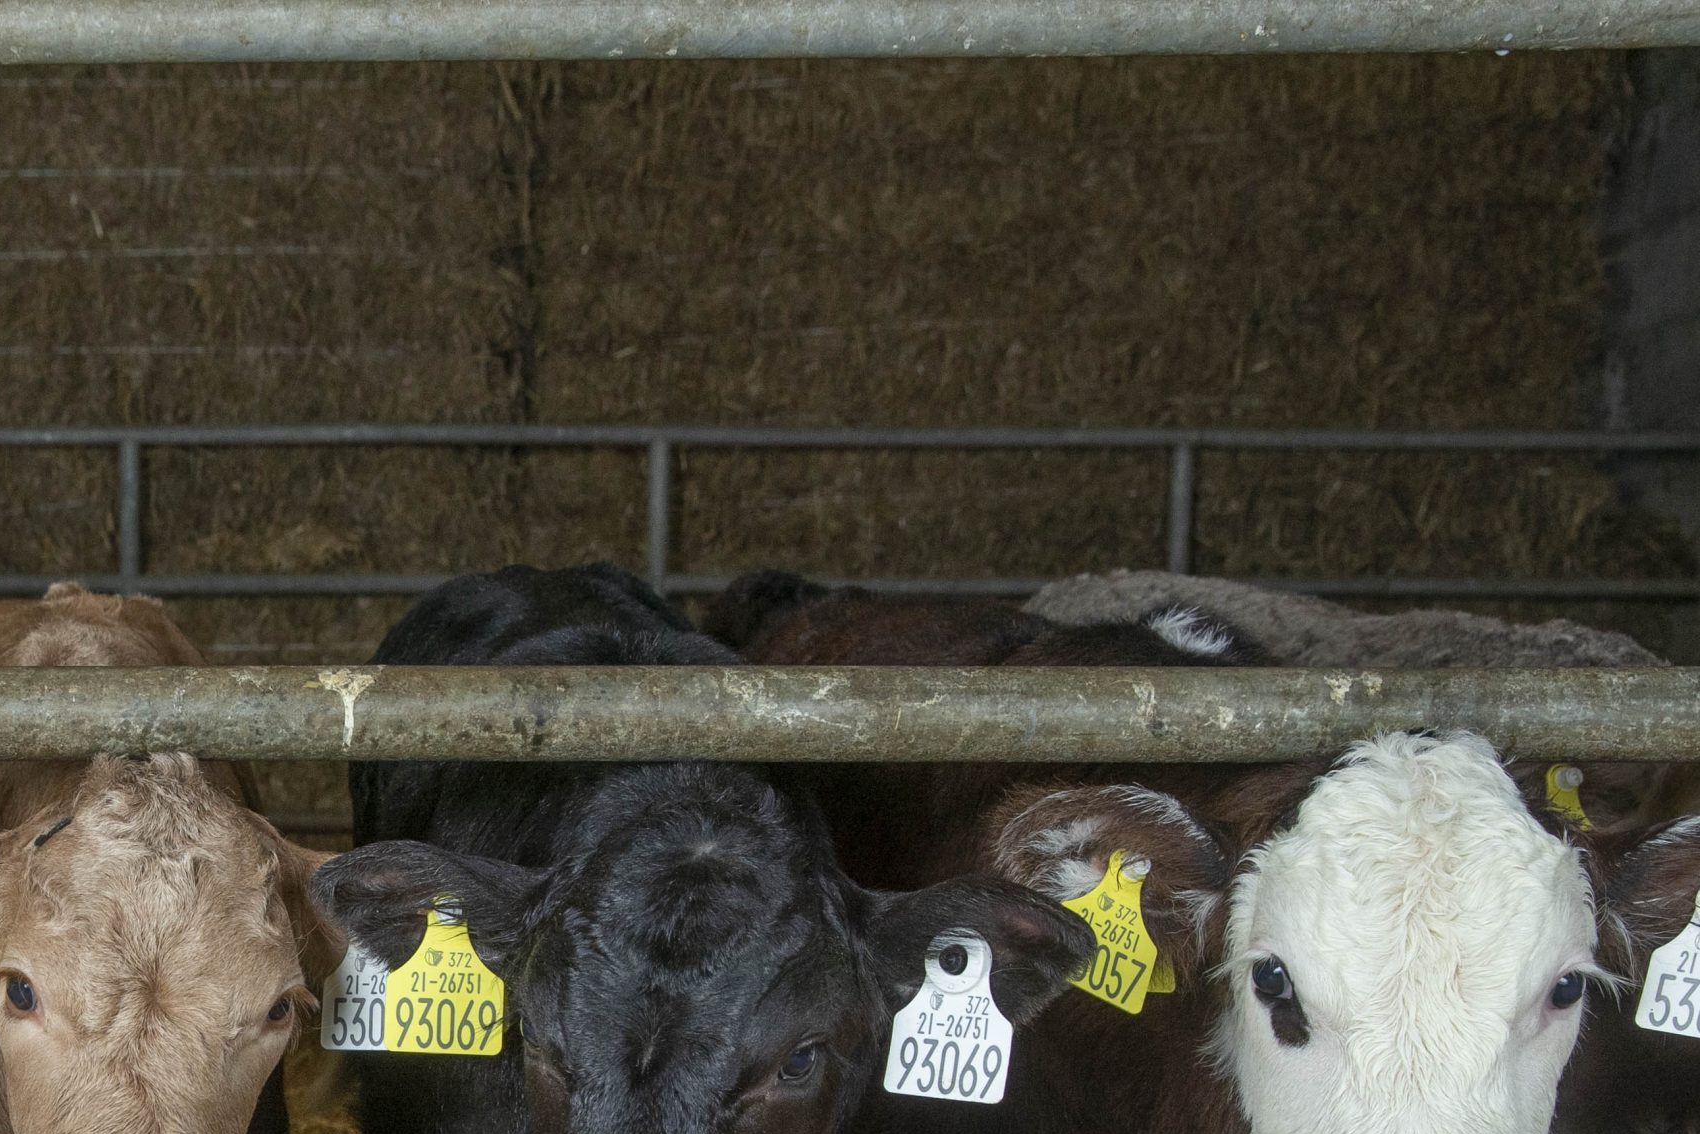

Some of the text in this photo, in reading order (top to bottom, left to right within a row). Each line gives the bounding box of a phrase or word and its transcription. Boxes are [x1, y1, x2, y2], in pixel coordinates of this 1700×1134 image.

[1115, 904, 1138, 927] 372
[448, 952, 472, 968] 372
[1075, 944, 1147, 1004] 057
[411, 971, 482, 995] 21-26751
[965, 995, 990, 1016] 372
[1648, 973, 1700, 1032] 53
[395, 997, 497, 1051] 93069
[917, 1012, 989, 1040] 21-26751
[897, 1036, 1003, 1099] 93069
